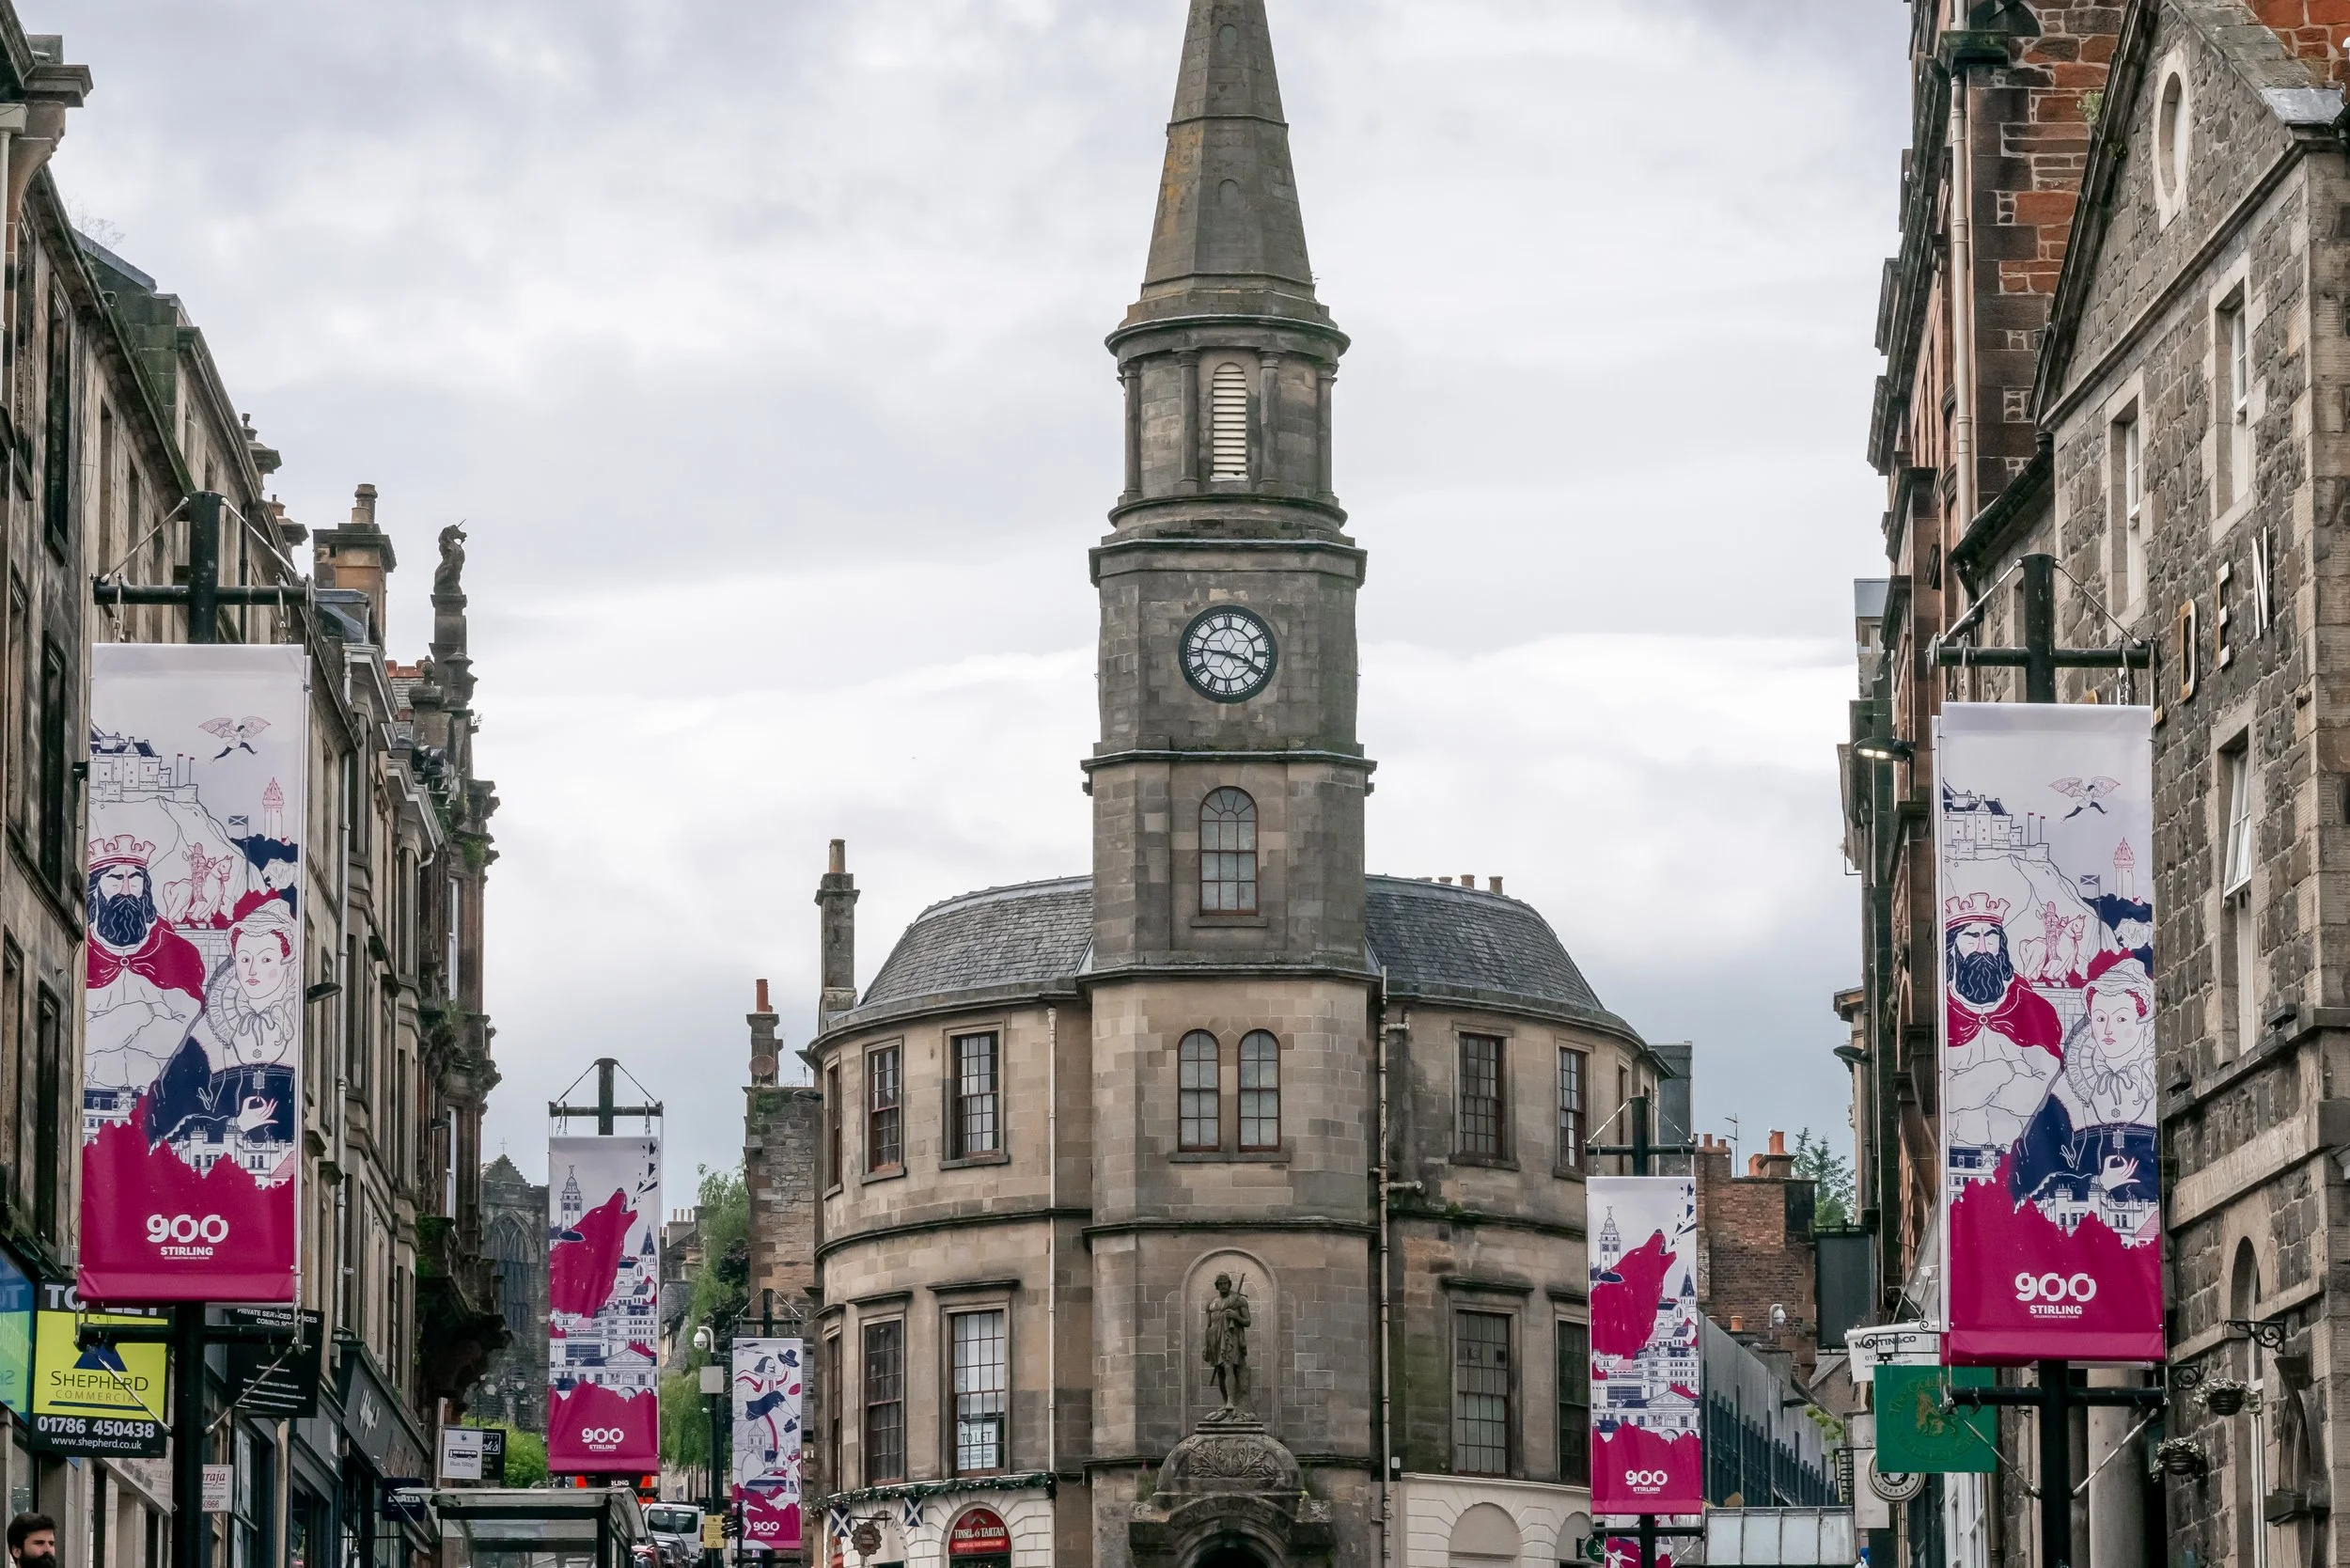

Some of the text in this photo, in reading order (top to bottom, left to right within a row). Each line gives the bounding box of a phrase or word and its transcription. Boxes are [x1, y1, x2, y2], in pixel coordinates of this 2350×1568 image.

[2154, 526, 2268, 724] DEN
[147, 1214, 229, 1243] 900
[160, 1247, 213, 1256] STIRLING
[2014, 1272, 2097, 1302] 900
[2029, 1305, 2082, 1314] STIRLING
[262, 1310, 291, 1320] SERCED
[293, 1314, 318, 1324] FICES
[50, 1371, 149, 1391] SHEPHERD
[37, 1416, 155, 1438] 01786 450438
[582, 1427, 624, 1443] 900
[961, 1431, 993, 1445] TO LET
[51, 1437, 142, 1450] www.shepherd.co.uk
[482, 1440, 498, 1451] ck's
[1625, 1469, 1668, 1486] 900
[1878, 1482, 1909, 1493] COFFEE
[203, 1499, 219, 1509] 0966
[753, 1521, 780, 1531] 900
[954, 1529, 974, 1539] TINSEL
[980, 1527, 1005, 1537] TARTAN
